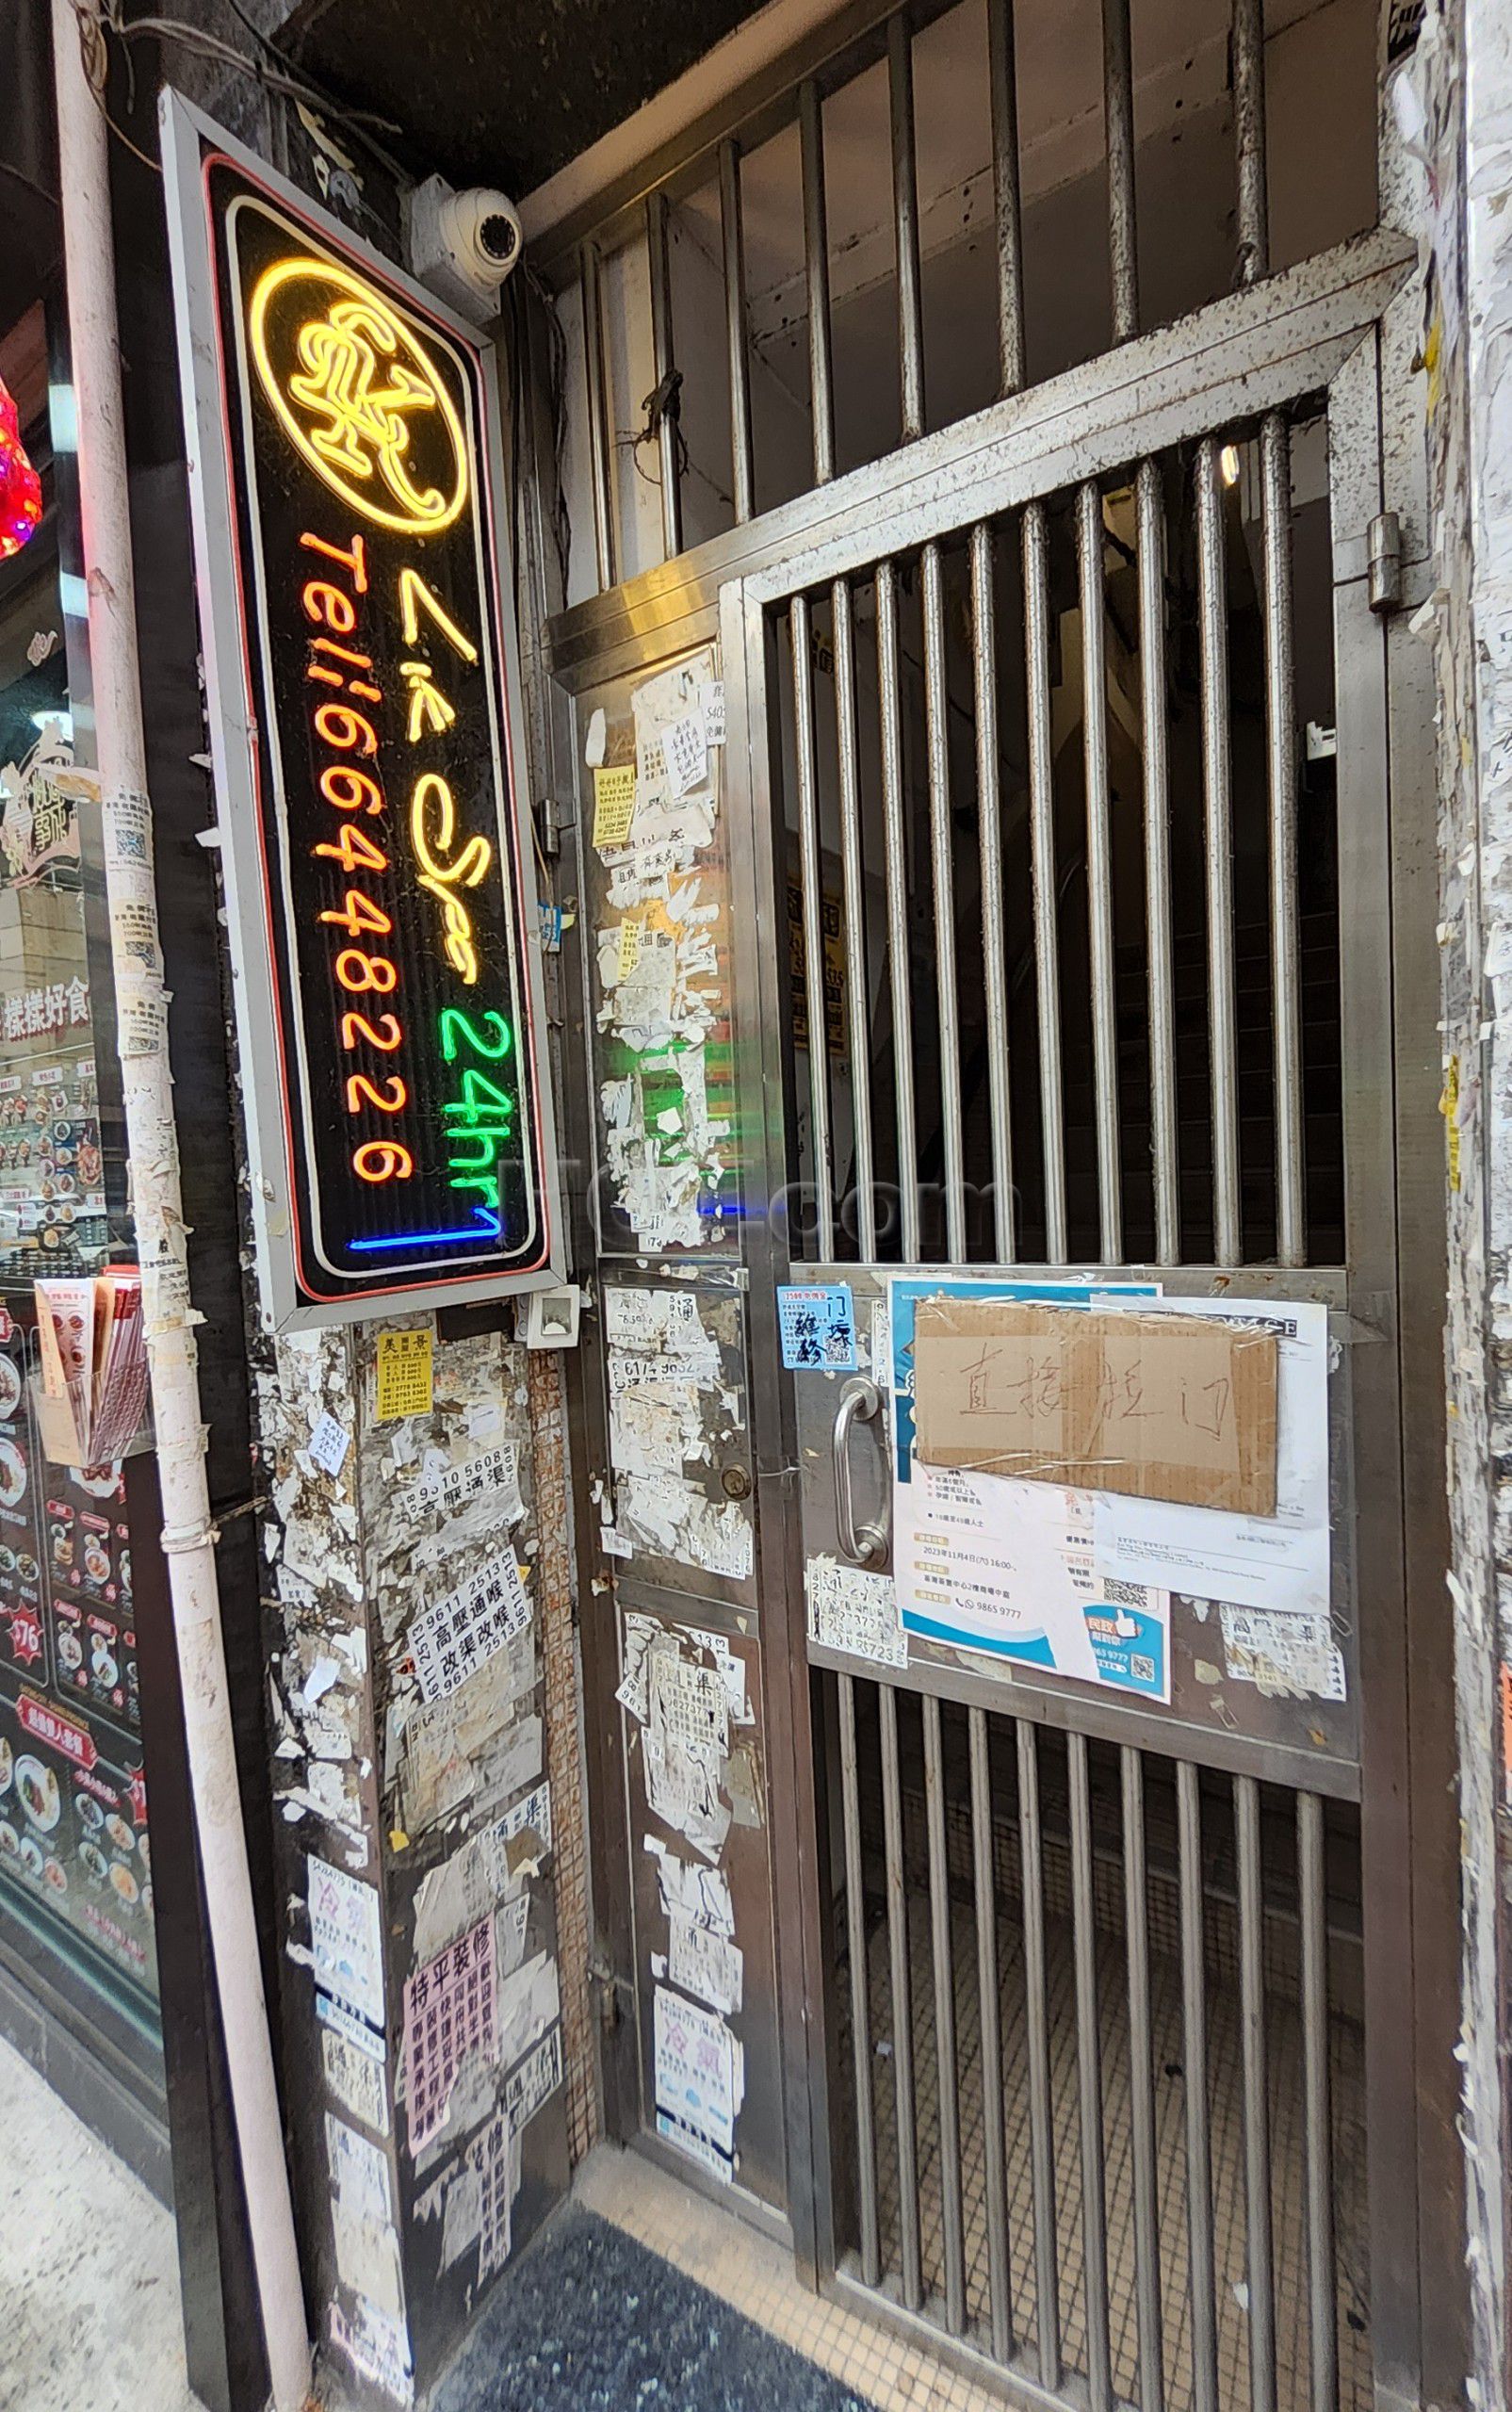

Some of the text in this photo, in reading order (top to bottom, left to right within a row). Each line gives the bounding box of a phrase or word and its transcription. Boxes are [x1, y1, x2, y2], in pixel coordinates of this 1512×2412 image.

[439, 1007, 514, 1210] 24hr
[464, 1450, 501, 1477] 5608
[426, 1563, 501, 1629] 9611 2513
[431, 1578, 505, 1653] 高壓通喉
[976, 1601, 1021, 1620] 9865 9777
[444, 1622, 515, 1693] 9611 2513
[410, 1923, 491, 2016] 特平裝修
